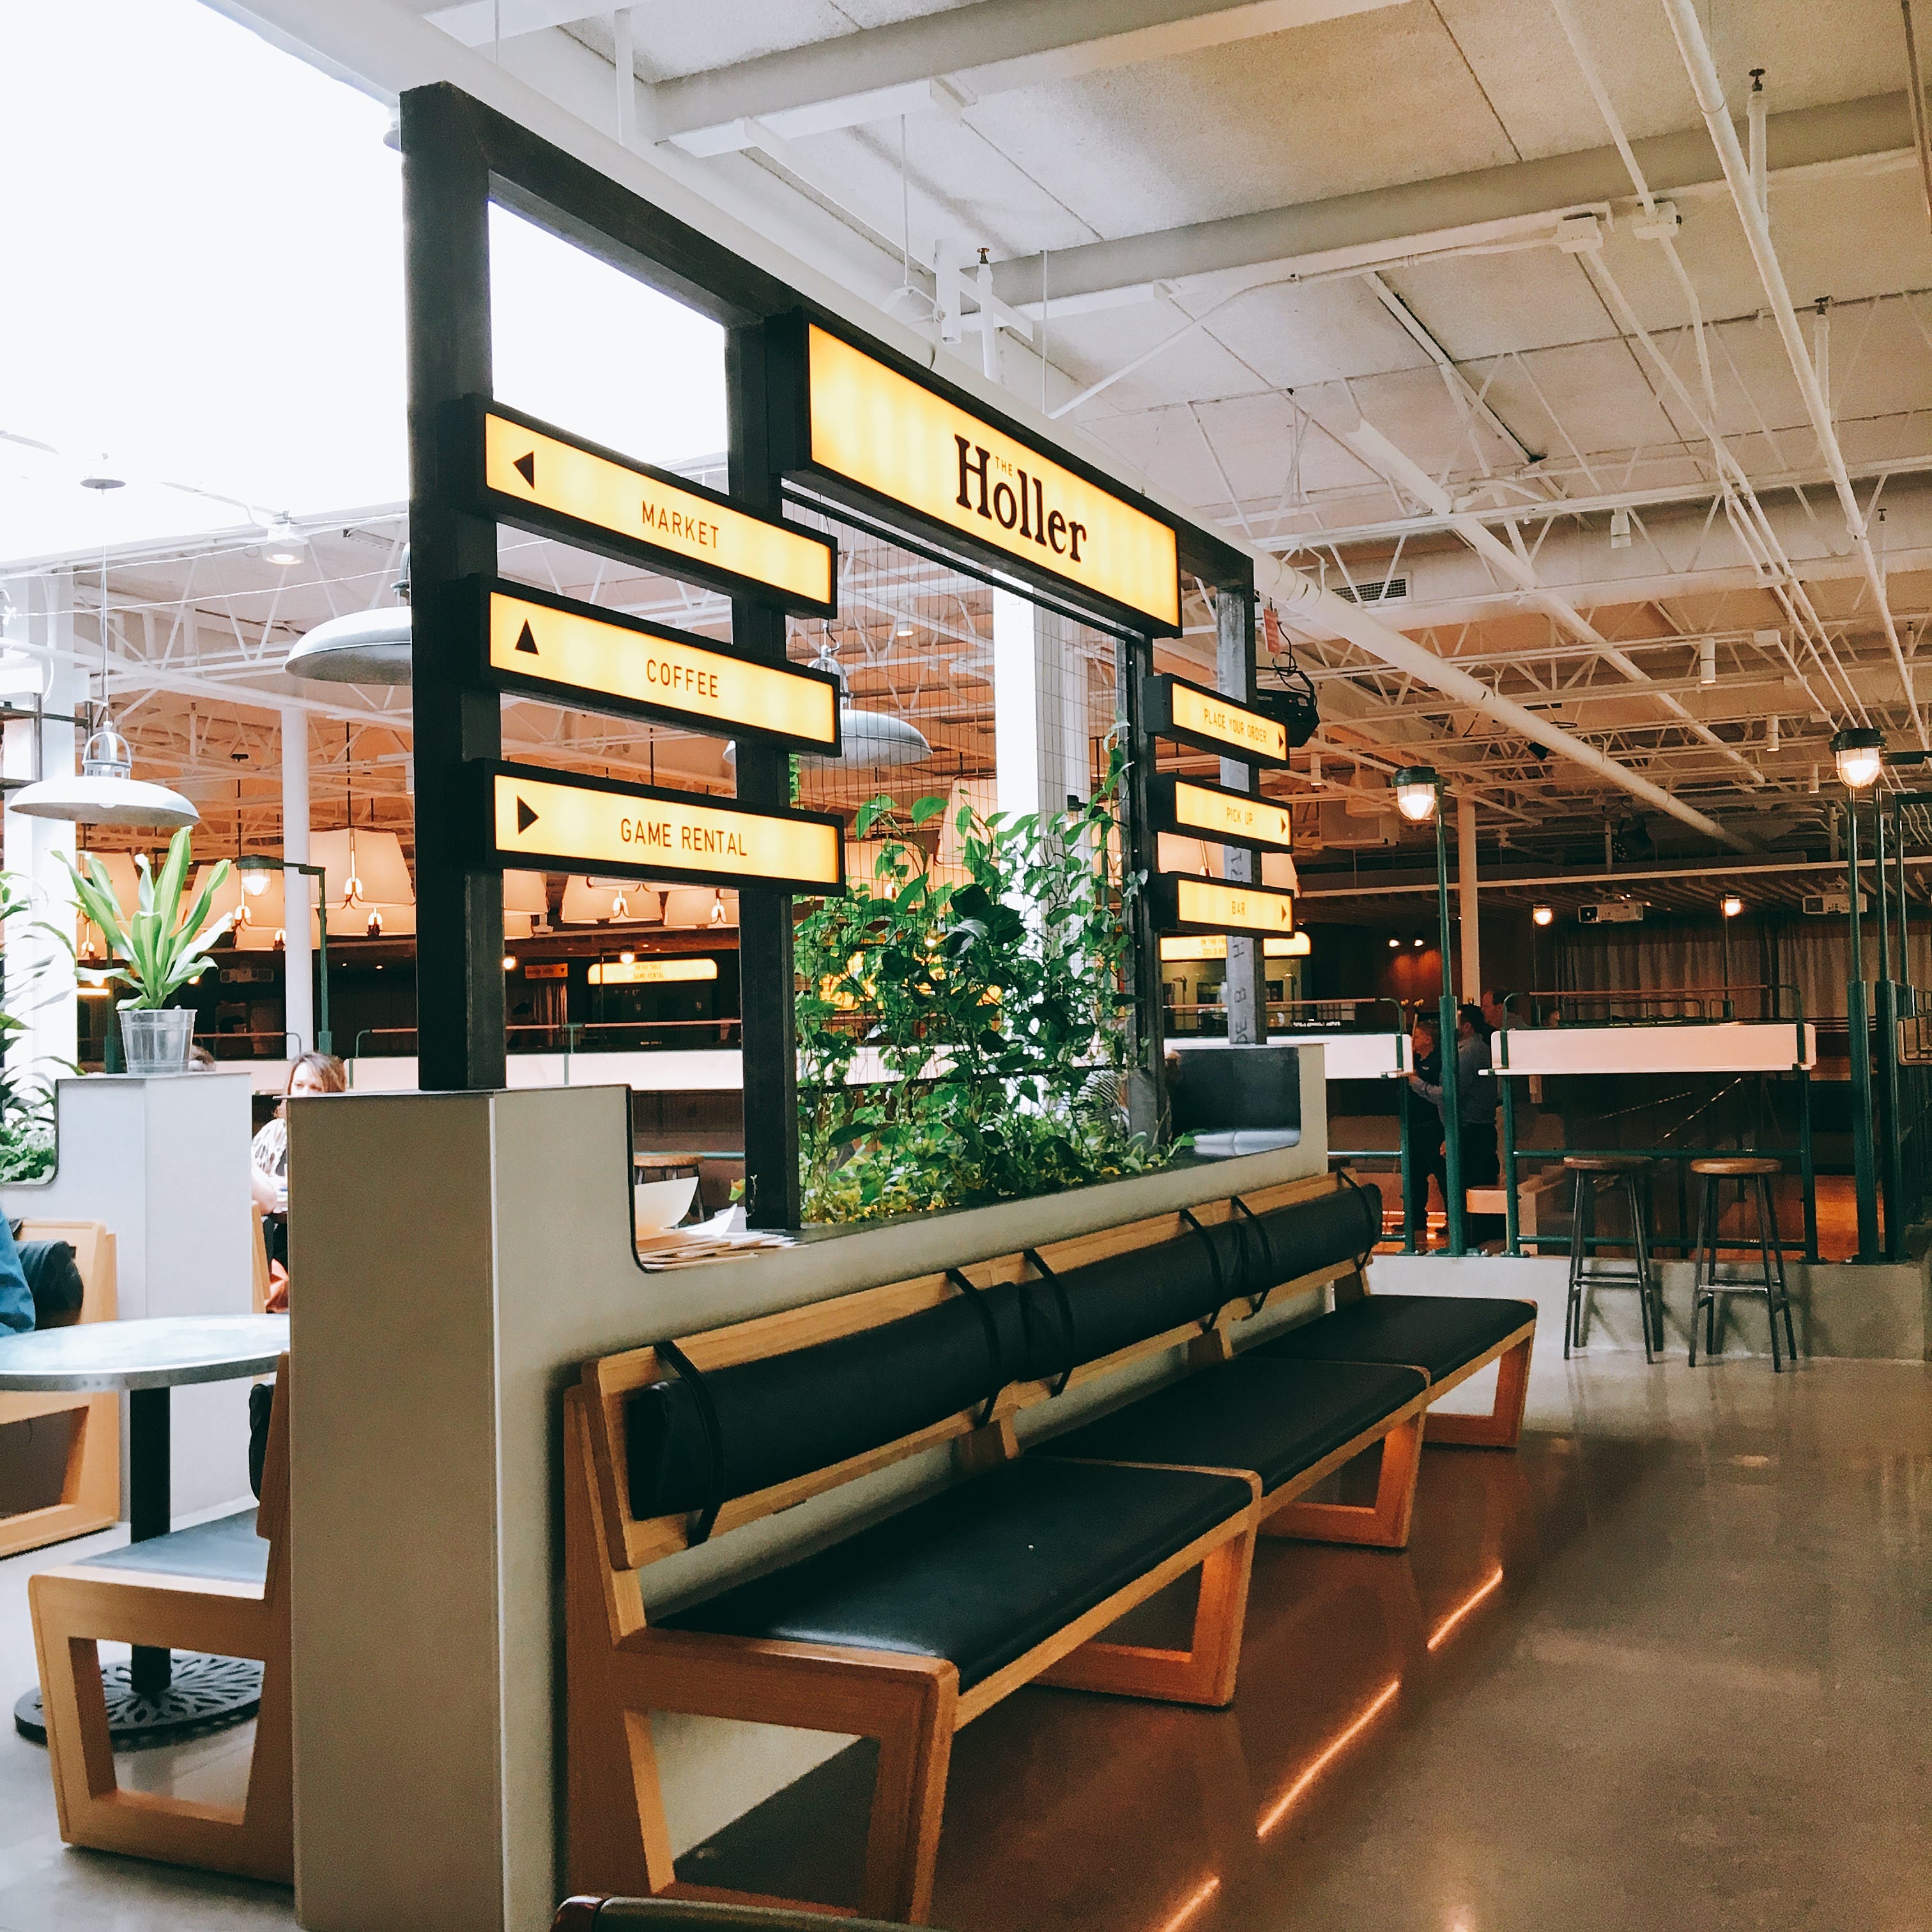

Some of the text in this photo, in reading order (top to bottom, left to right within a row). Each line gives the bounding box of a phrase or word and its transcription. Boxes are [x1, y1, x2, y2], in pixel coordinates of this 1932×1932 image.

[995, 456, 1013, 477] THE
[954, 433, 1087, 563] Holler
[641, 500, 719, 549] MARKET
[647, 659, 719, 699] COFFEE
[1204, 708, 1267, 744] PLACE YOUR ORDER
[1226, 806, 1252, 825] PICK UP
[620, 818, 747, 857] GAME RENTAL
[1231, 900, 1246, 916] BAR
